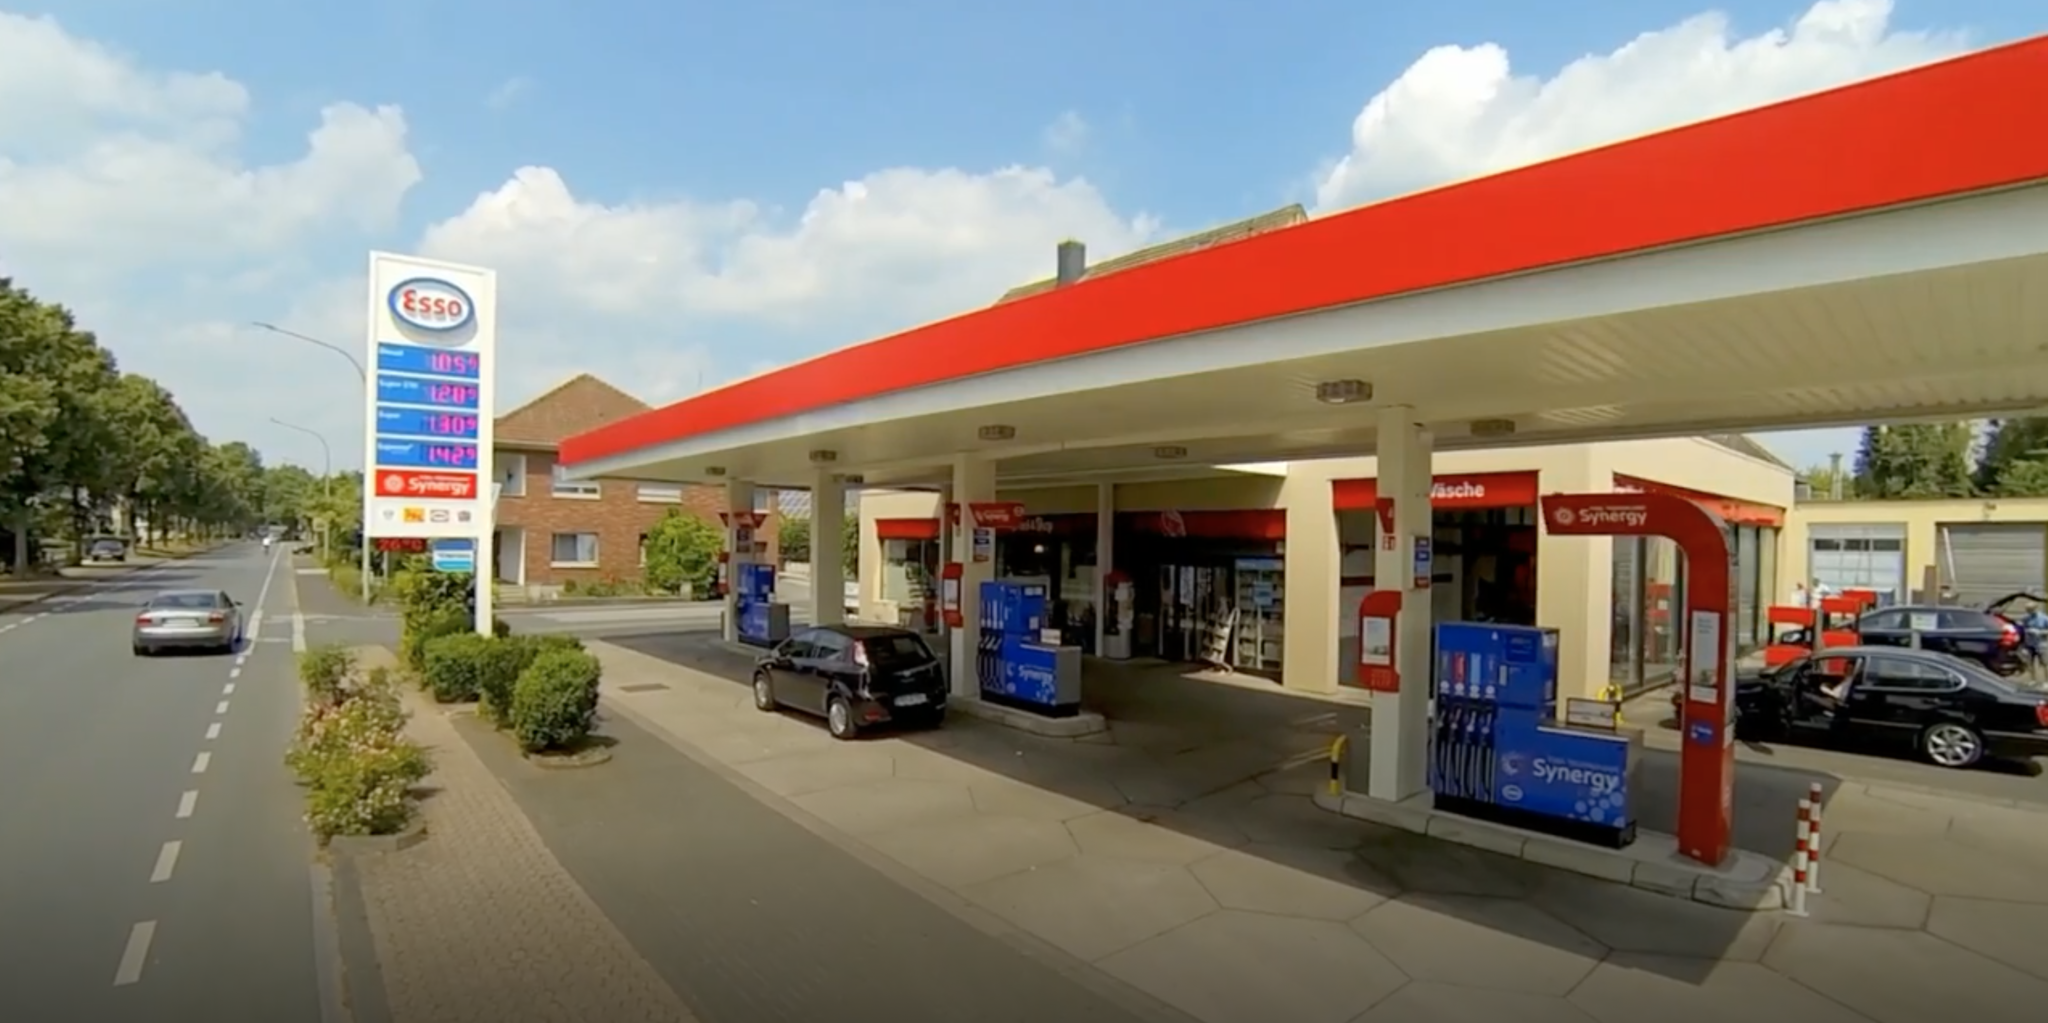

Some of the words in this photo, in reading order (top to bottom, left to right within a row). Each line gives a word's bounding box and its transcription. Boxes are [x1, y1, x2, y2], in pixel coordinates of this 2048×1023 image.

[403, 289, 463, 318] Esso
[408, 476, 471, 496] Synergy
[1579, 508, 1648, 527] Synergy
[1533, 758, 1619, 794] Synergy
